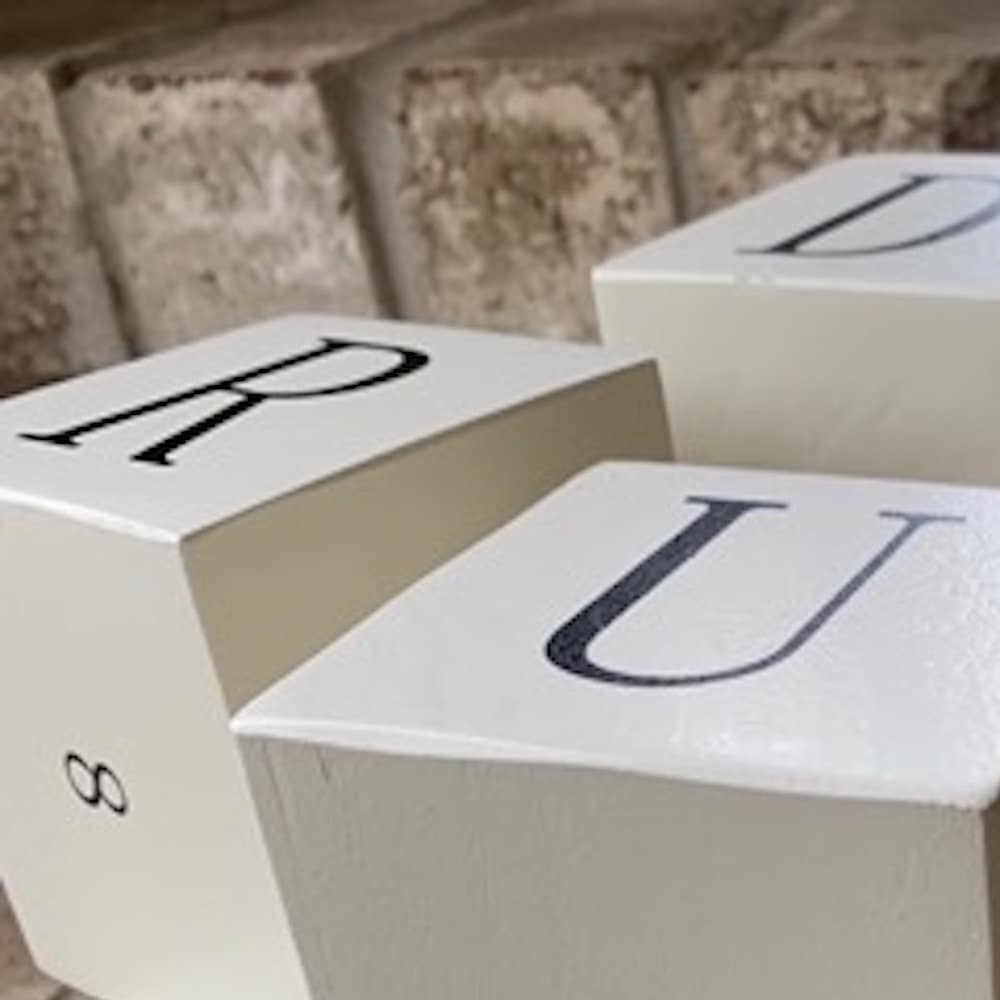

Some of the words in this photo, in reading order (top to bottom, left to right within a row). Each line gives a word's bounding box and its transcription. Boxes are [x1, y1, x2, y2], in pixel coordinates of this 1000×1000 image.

[18, 336, 431, 467] R
[544, 495, 968, 689] U
[63, 751, 128, 817] 8
